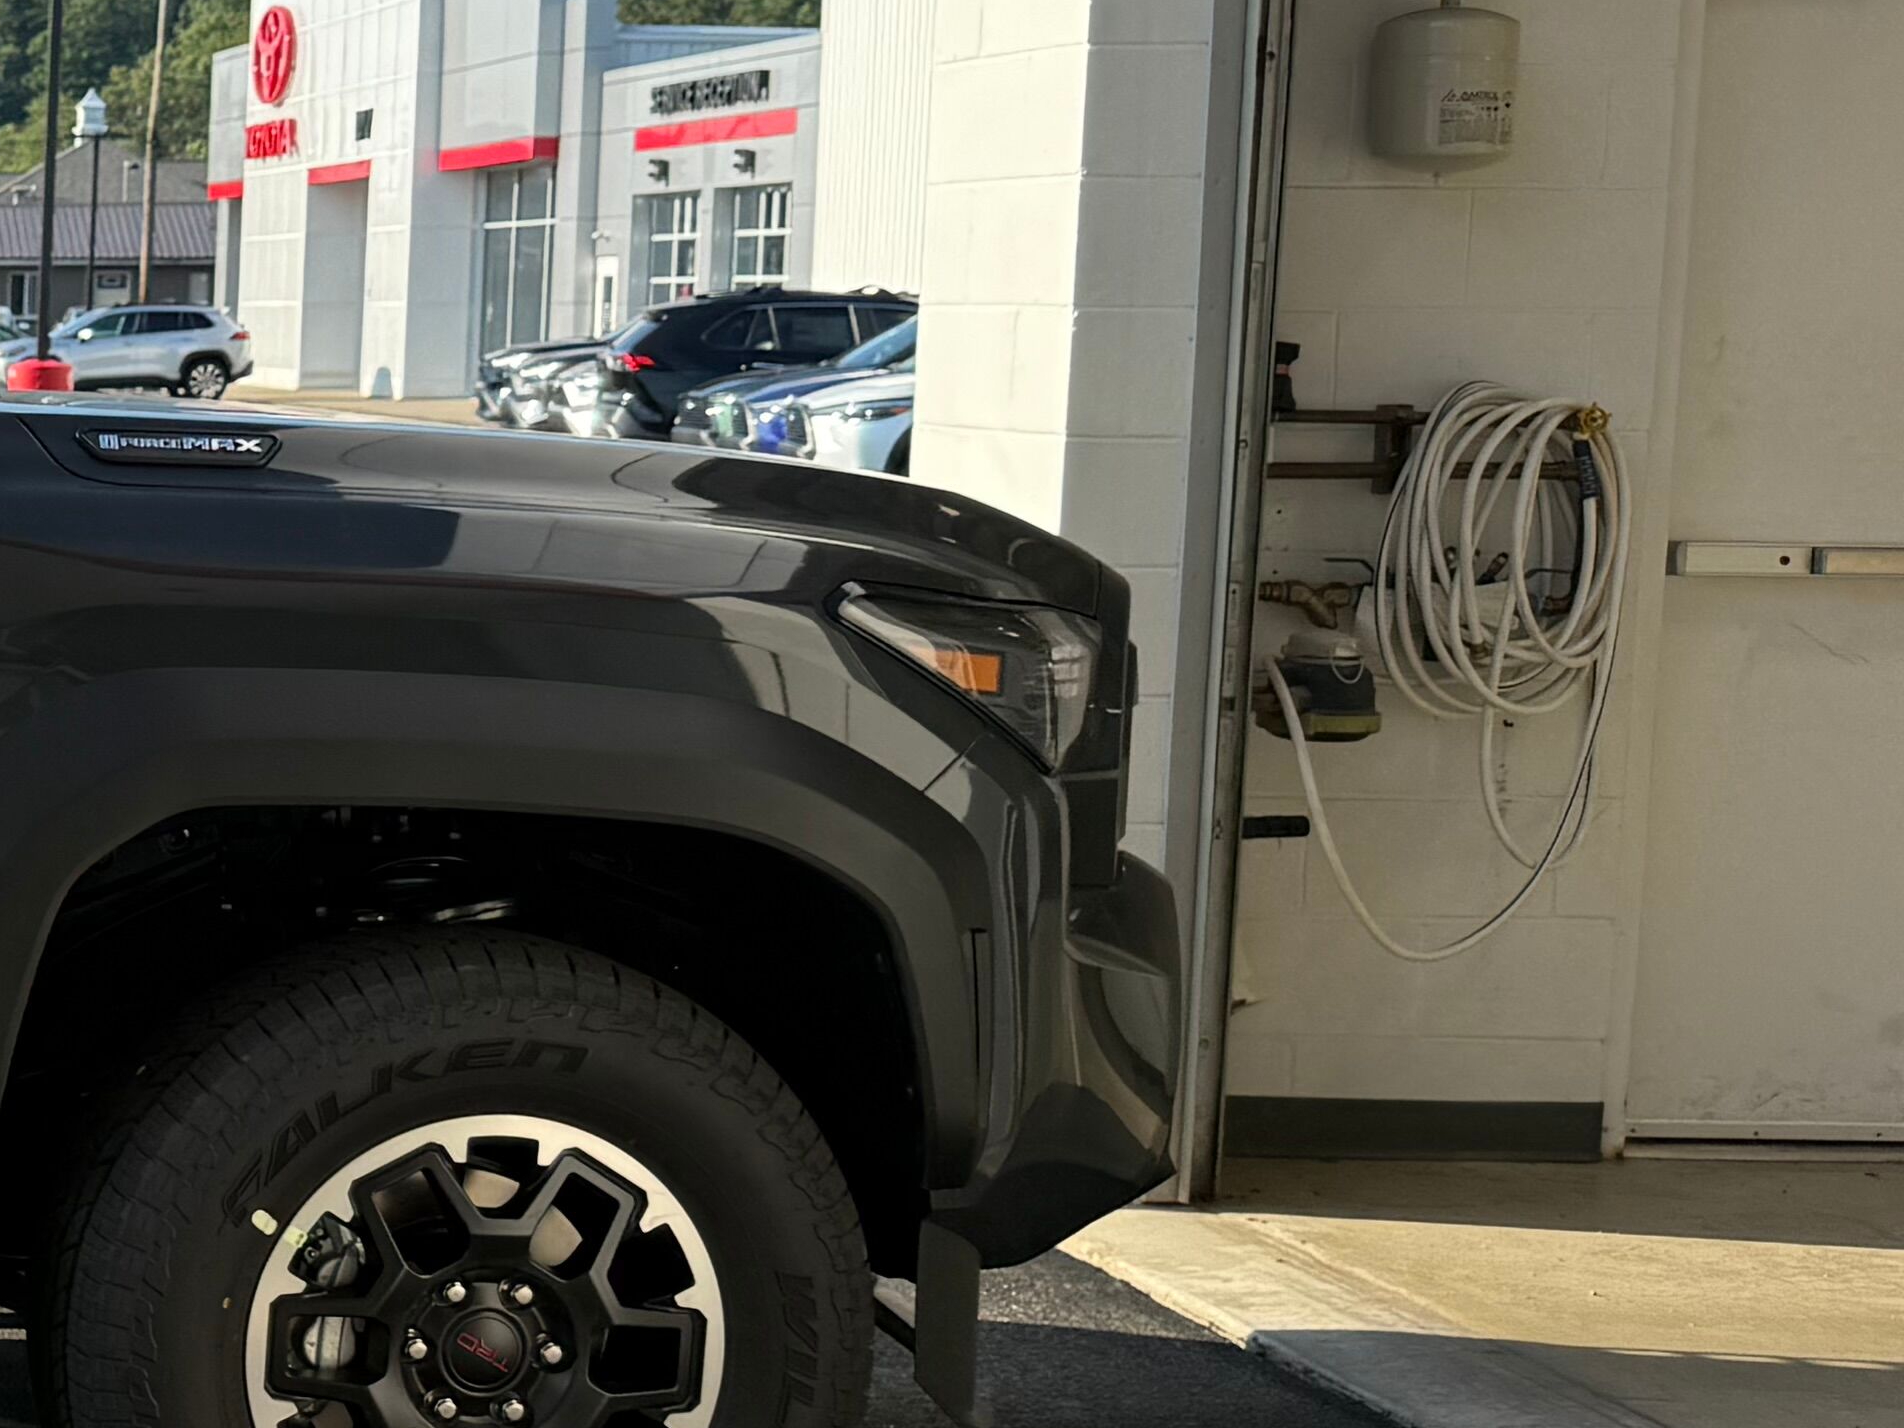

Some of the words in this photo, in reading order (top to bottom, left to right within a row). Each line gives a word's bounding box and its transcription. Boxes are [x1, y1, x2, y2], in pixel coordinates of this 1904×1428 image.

[245, 119, 297, 160] TOYOTA
[220, 1037, 589, 1235] FALKEN
[457, 1332, 509, 1373] TRD
